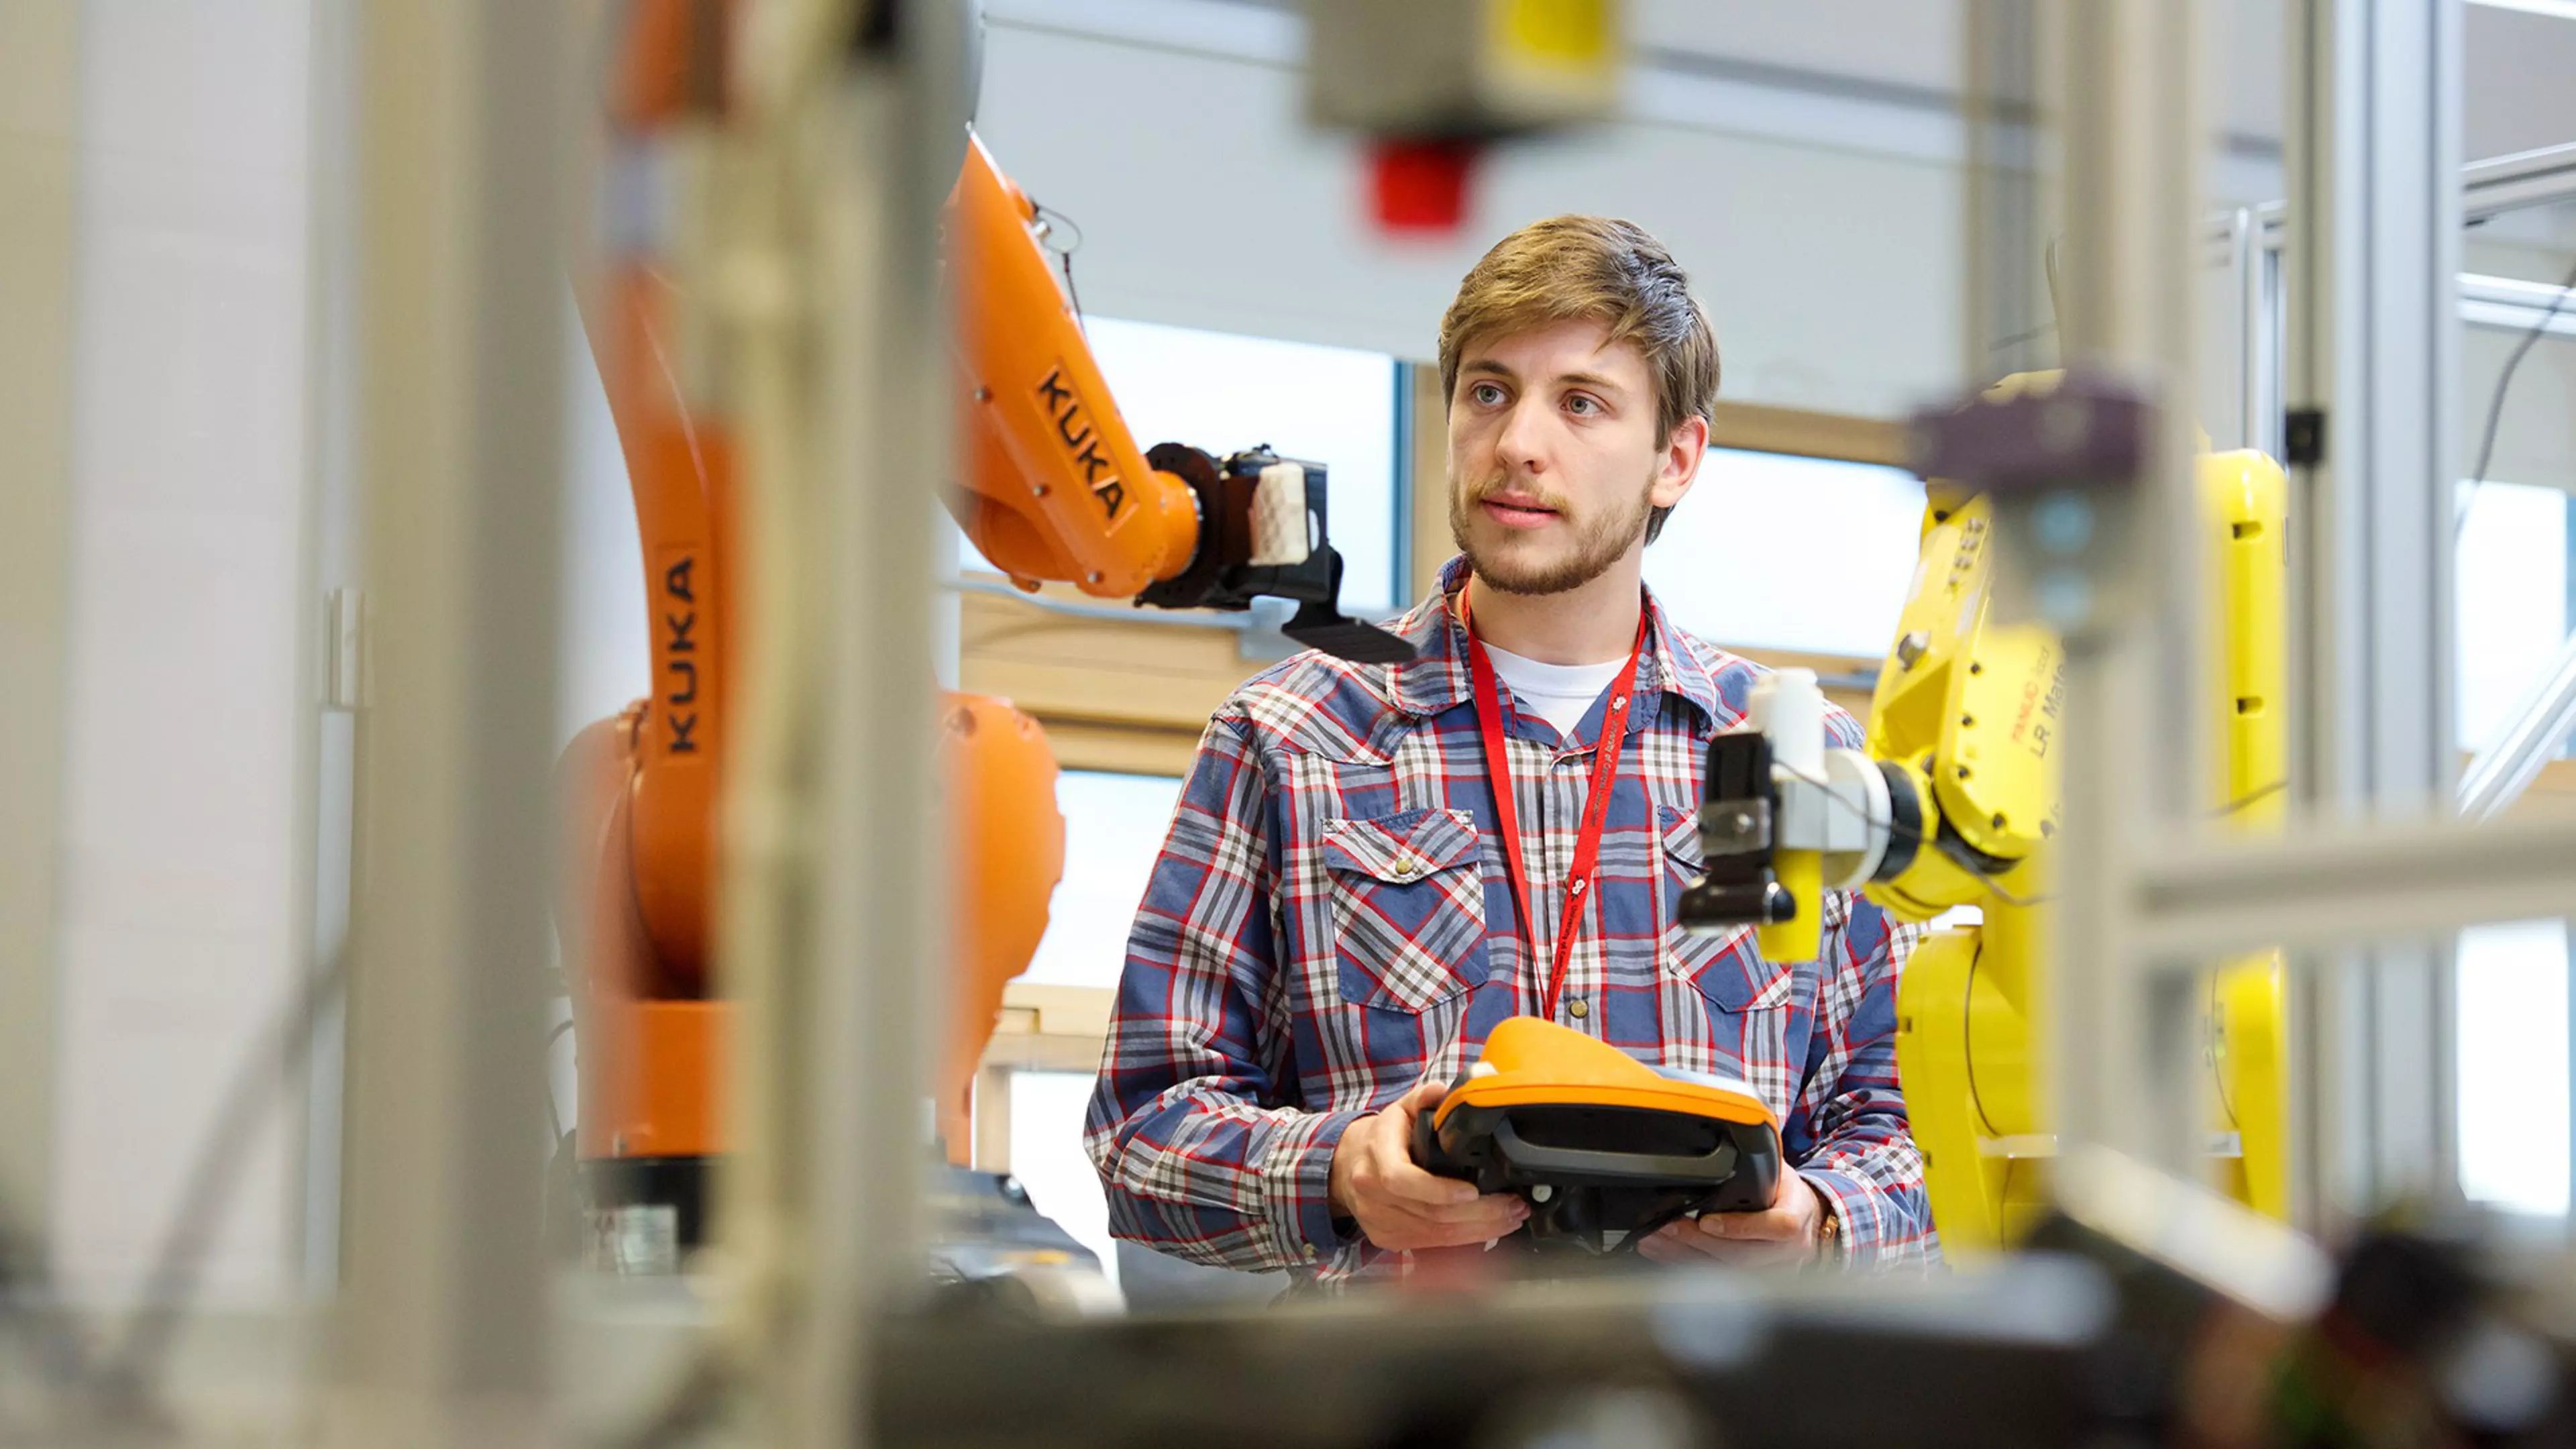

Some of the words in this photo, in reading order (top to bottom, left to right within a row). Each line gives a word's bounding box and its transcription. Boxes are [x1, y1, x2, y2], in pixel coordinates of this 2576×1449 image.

[1038, 370, 1124, 519] KUKA
[666, 557, 698, 752] KUKA
[2029, 724, 2051, 759] LR
